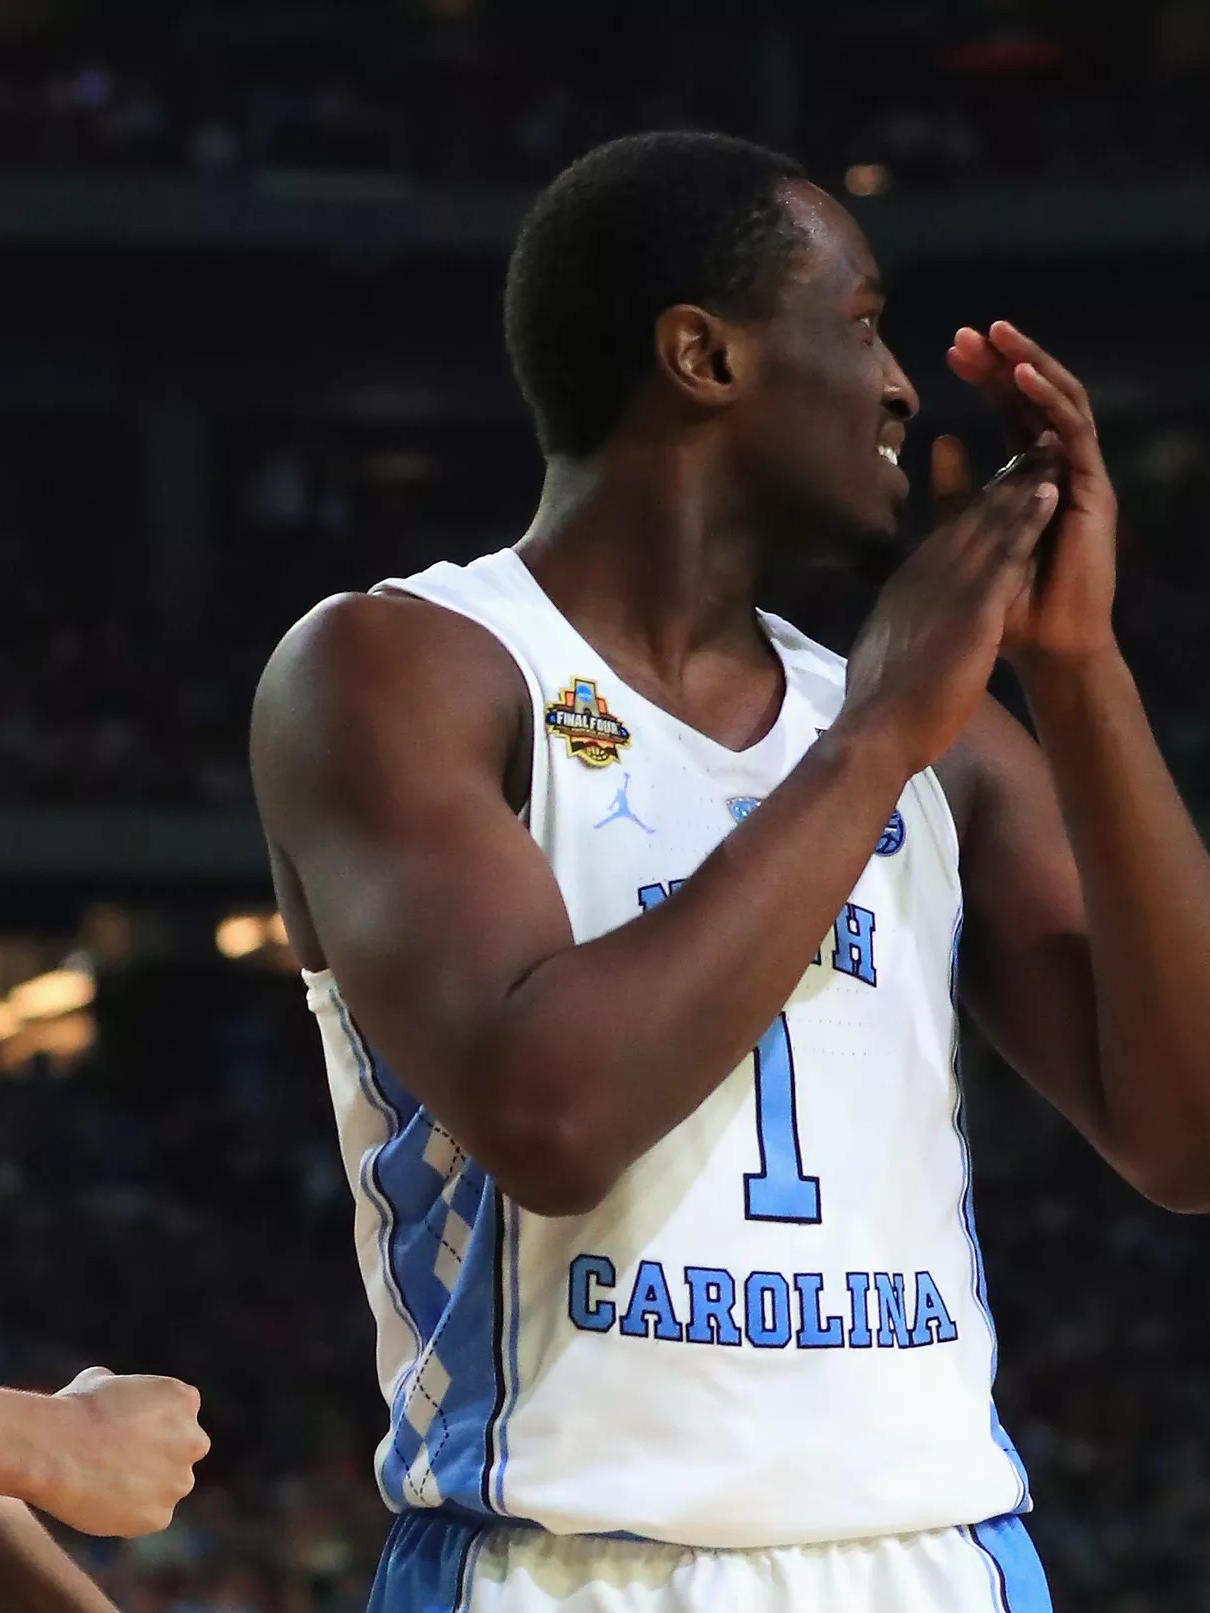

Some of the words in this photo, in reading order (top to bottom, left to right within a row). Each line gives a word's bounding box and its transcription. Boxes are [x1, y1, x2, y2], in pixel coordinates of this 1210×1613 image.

[556, 711, 589, 728] FINAL
[590, 718, 619, 737] FOUR
[743, 1011, 821, 1224] 1
[568, 1254, 958, 1349] CAROLINA
